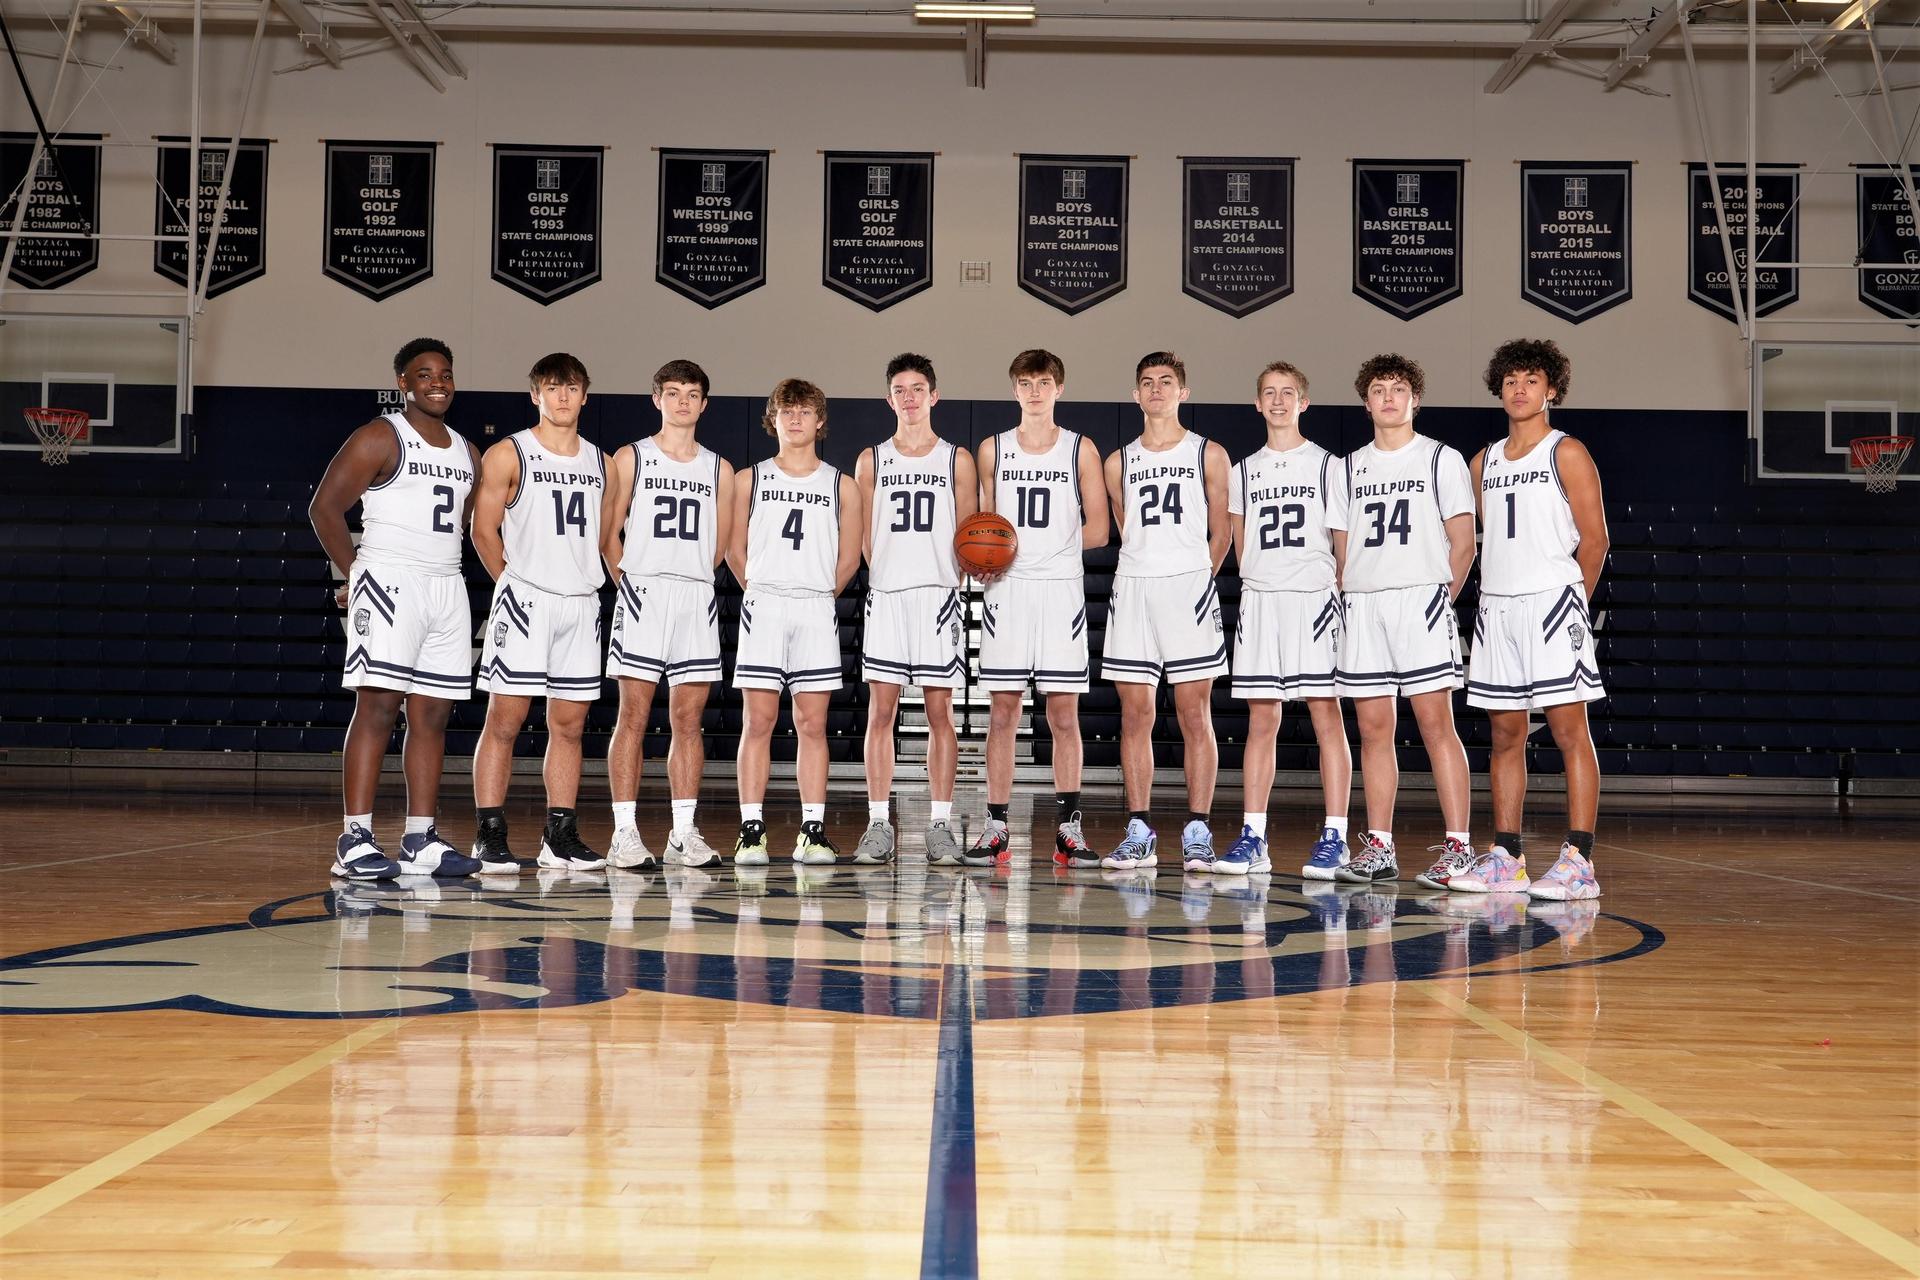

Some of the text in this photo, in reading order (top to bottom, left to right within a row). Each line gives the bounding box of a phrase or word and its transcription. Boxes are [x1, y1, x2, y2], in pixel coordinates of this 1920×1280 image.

[360, 188, 400, 198] GIRLS
[528, 193, 568, 202] GIRLS
[696, 196, 731, 206] BOYS
[859, 200, 899, 209] GIRLS
[362, 202, 398, 212] GOLF
[530, 207, 566, 216] GOLF
[1056, 203, 1092, 212] BOYS
[1219, 206, 1259, 216] GIRLS
[29, 208, 61, 218] 1982
[673, 209, 753, 220] WRESTLING
[1388, 207, 1428, 217] GIRLS
[1558, 211, 1594, 220] BOYS
[198, 213, 228, 223] 196
[364, 215, 396, 225] 1992
[861, 213, 896, 222] GOLF
[1030, 216, 1118, 226] BASKETBALL
[1727, 214, 1760, 223] BOS
[532, 220, 564, 229] 1993
[697, 223, 728, 233] 1999
[1194, 220, 1283, 229] BASKETBALL
[1364, 221, 1452, 230] BASKETBALL
[1541, 224, 1611, 234] FOOTBALL
[165, 225, 258, 235] STAT CHMPIONS
[334, 228, 425, 237] STATE CHAMPIONS
[863, 226, 895, 236] 2002
[1058, 230, 1088, 239] 2011
[1702, 226, 1784, 235] BAKEBALL
[502, 232, 593, 241] STATE CHAMPIONS
[700, 237, 758, 245] CHAMPIONS
[1223, 233, 1255, 242] 2014
[1391, 234, 1425, 245] 2015
[18, 238, 70, 247] GONZAGA
[1028, 242, 1118, 251] STATE CHAMPIONS
[1560, 238, 1593, 248] 2015
[14, 249, 81, 257] REPARATORY
[353, 245, 405, 254] GONZAGA
[522, 249, 572, 258] GONZAGA
[1193, 246, 1223, 254] STATE
[1395, 248, 1454, 256] CHAMPIONS
[20, 258, 66, 266] SCHOOL
[341, 255, 417, 264] PREPARATORY
[686, 253, 737, 262] GONZAGA
[853, 256, 904, 264] GONZAGA
[509, 259, 584, 268] PREPARATORY
[674, 263, 749, 272] PREPARATORY
[1048, 260, 1098, 268] GONZAGA
[1382, 264, 1433, 272] GONZAGA
[356, 265, 400, 274] SCHOOL
[524, 270, 568, 278] SCHOOL
[841, 266, 915, 274] PREPARATORY
[1035, 269, 1110, 278] PREPARATORY
[1551, 268, 1602, 276] GONZAGA
[689, 273, 733, 282] SCHOOL
[856, 276, 900, 284] SCHOOL
[1201, 273, 1276, 281] PREPARATORY
[1370, 274, 1444, 283] PREPARATORY
[1706, 272, 1779, 283] GOZGA
[1875, 274, 1920, 284] GONZ
[1050, 280, 1094, 288] SCHOOL
[1539, 278, 1614, 286] PREPARATORY
[1216, 283, 1260, 291] SCHOOL
[1385, 285, 1430, 293] SCHOOL
[1554, 288, 1598, 296] SCHOOL
[408, 462, 472, 485] BULLPUPS
[1002, 470, 1069, 483] BULLPUPS
[1130, 466, 1195, 484] BULLPUPS
[533, 471, 601, 489] BULLPUPS
[881, 474, 947, 488] BULLPUPS
[1483, 471, 1550, 492] BULLPUPS
[644, 478, 711, 497] BULLPUPS
[1355, 480, 1425, 499] BULLPUPS
[762, 490, 830, 507] BULLPUPS
[1250, 486, 1316, 504] BULLPUPS
[433, 484, 454, 534] 2
[1016, 487, 1050, 528] 10
[1139, 483, 1183, 527] 24
[552, 490, 587, 537] 14
[890, 491, 935, 532] 30
[1505, 493, 1515, 539] 1
[653, 495, 700, 541] 20
[1259, 504, 1305, 550] 22
[1364, 499, 1411, 547] 34
[781, 508, 804, 550] 4
